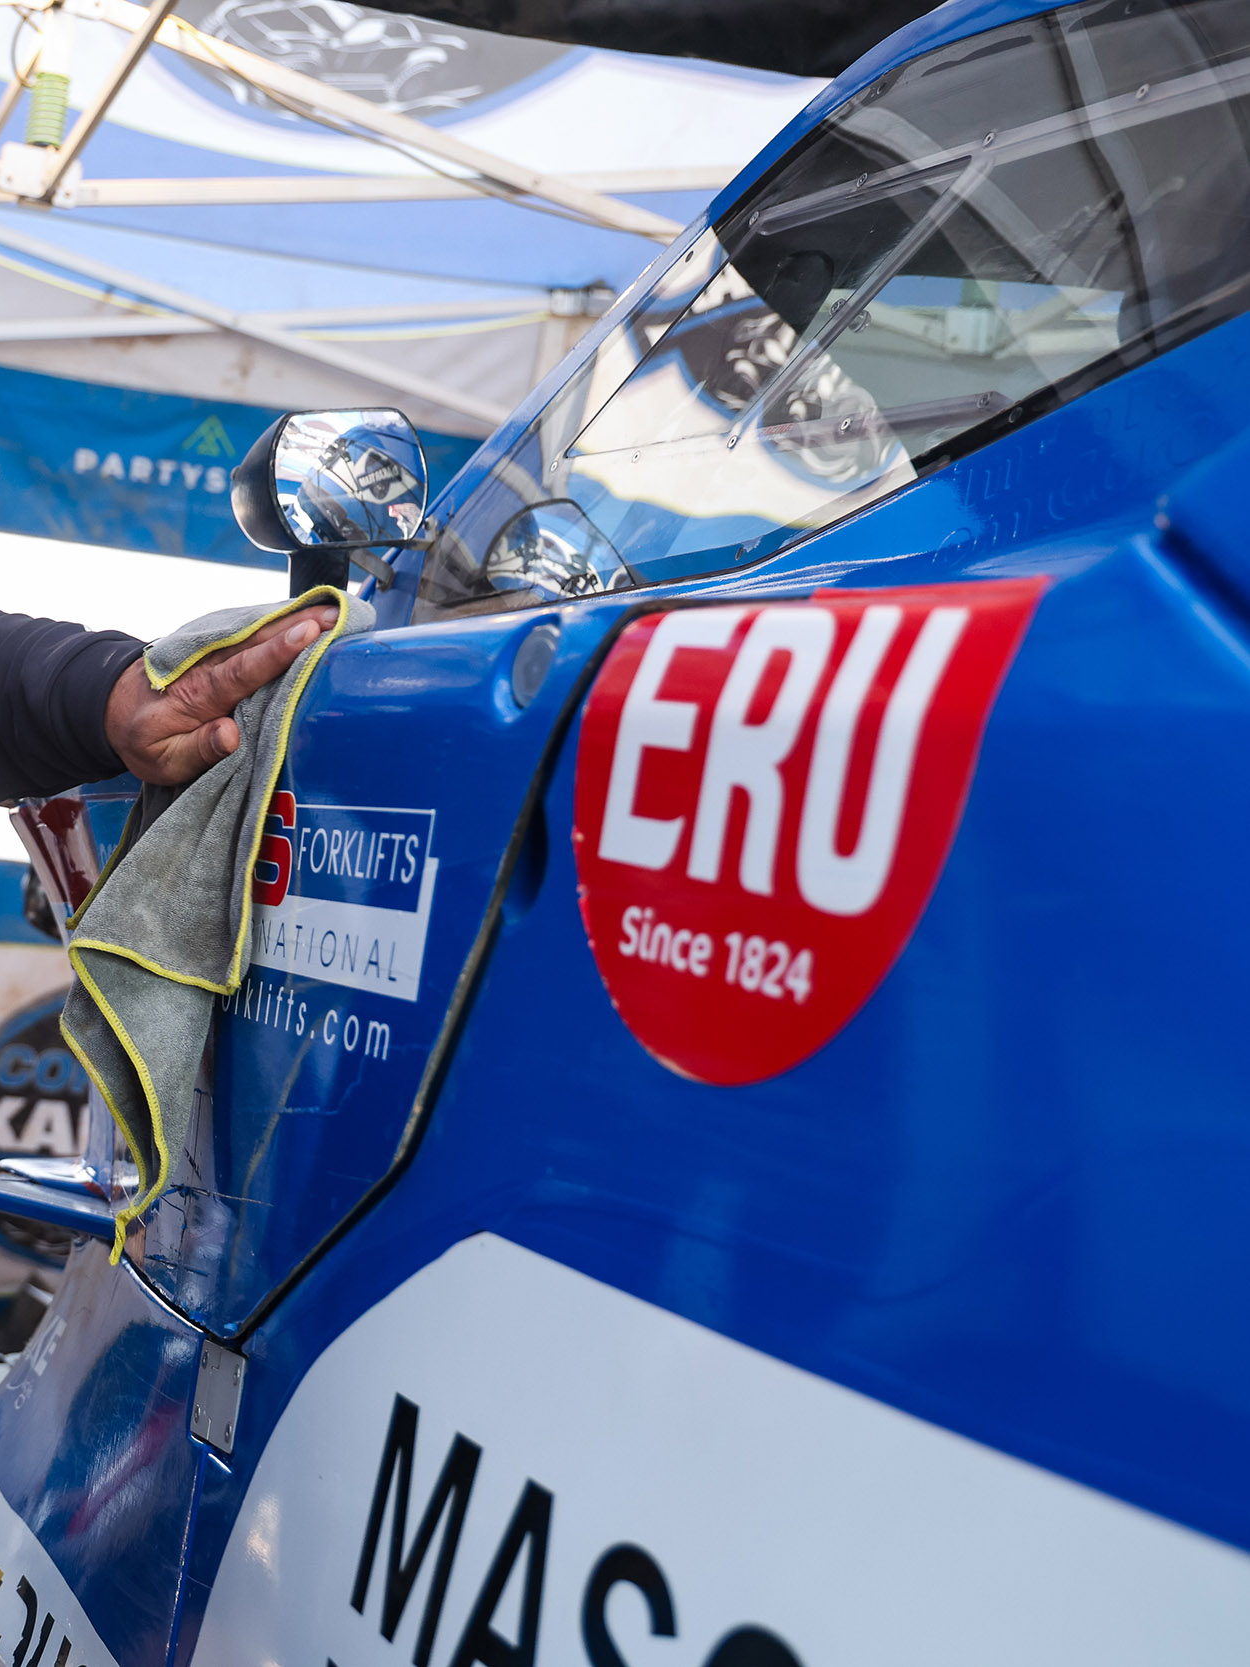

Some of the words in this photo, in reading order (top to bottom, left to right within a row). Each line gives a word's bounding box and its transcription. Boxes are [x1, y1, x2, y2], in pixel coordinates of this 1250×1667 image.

[598, 605, 972, 918] ERU
[297, 827, 420, 885] FORKLIFTS
[250, 916, 399, 983] NATIONAL
[618, 905, 713, 977] Since
[725, 931, 814, 1005] 1824
[350, 1391, 806, 1667] MAS
